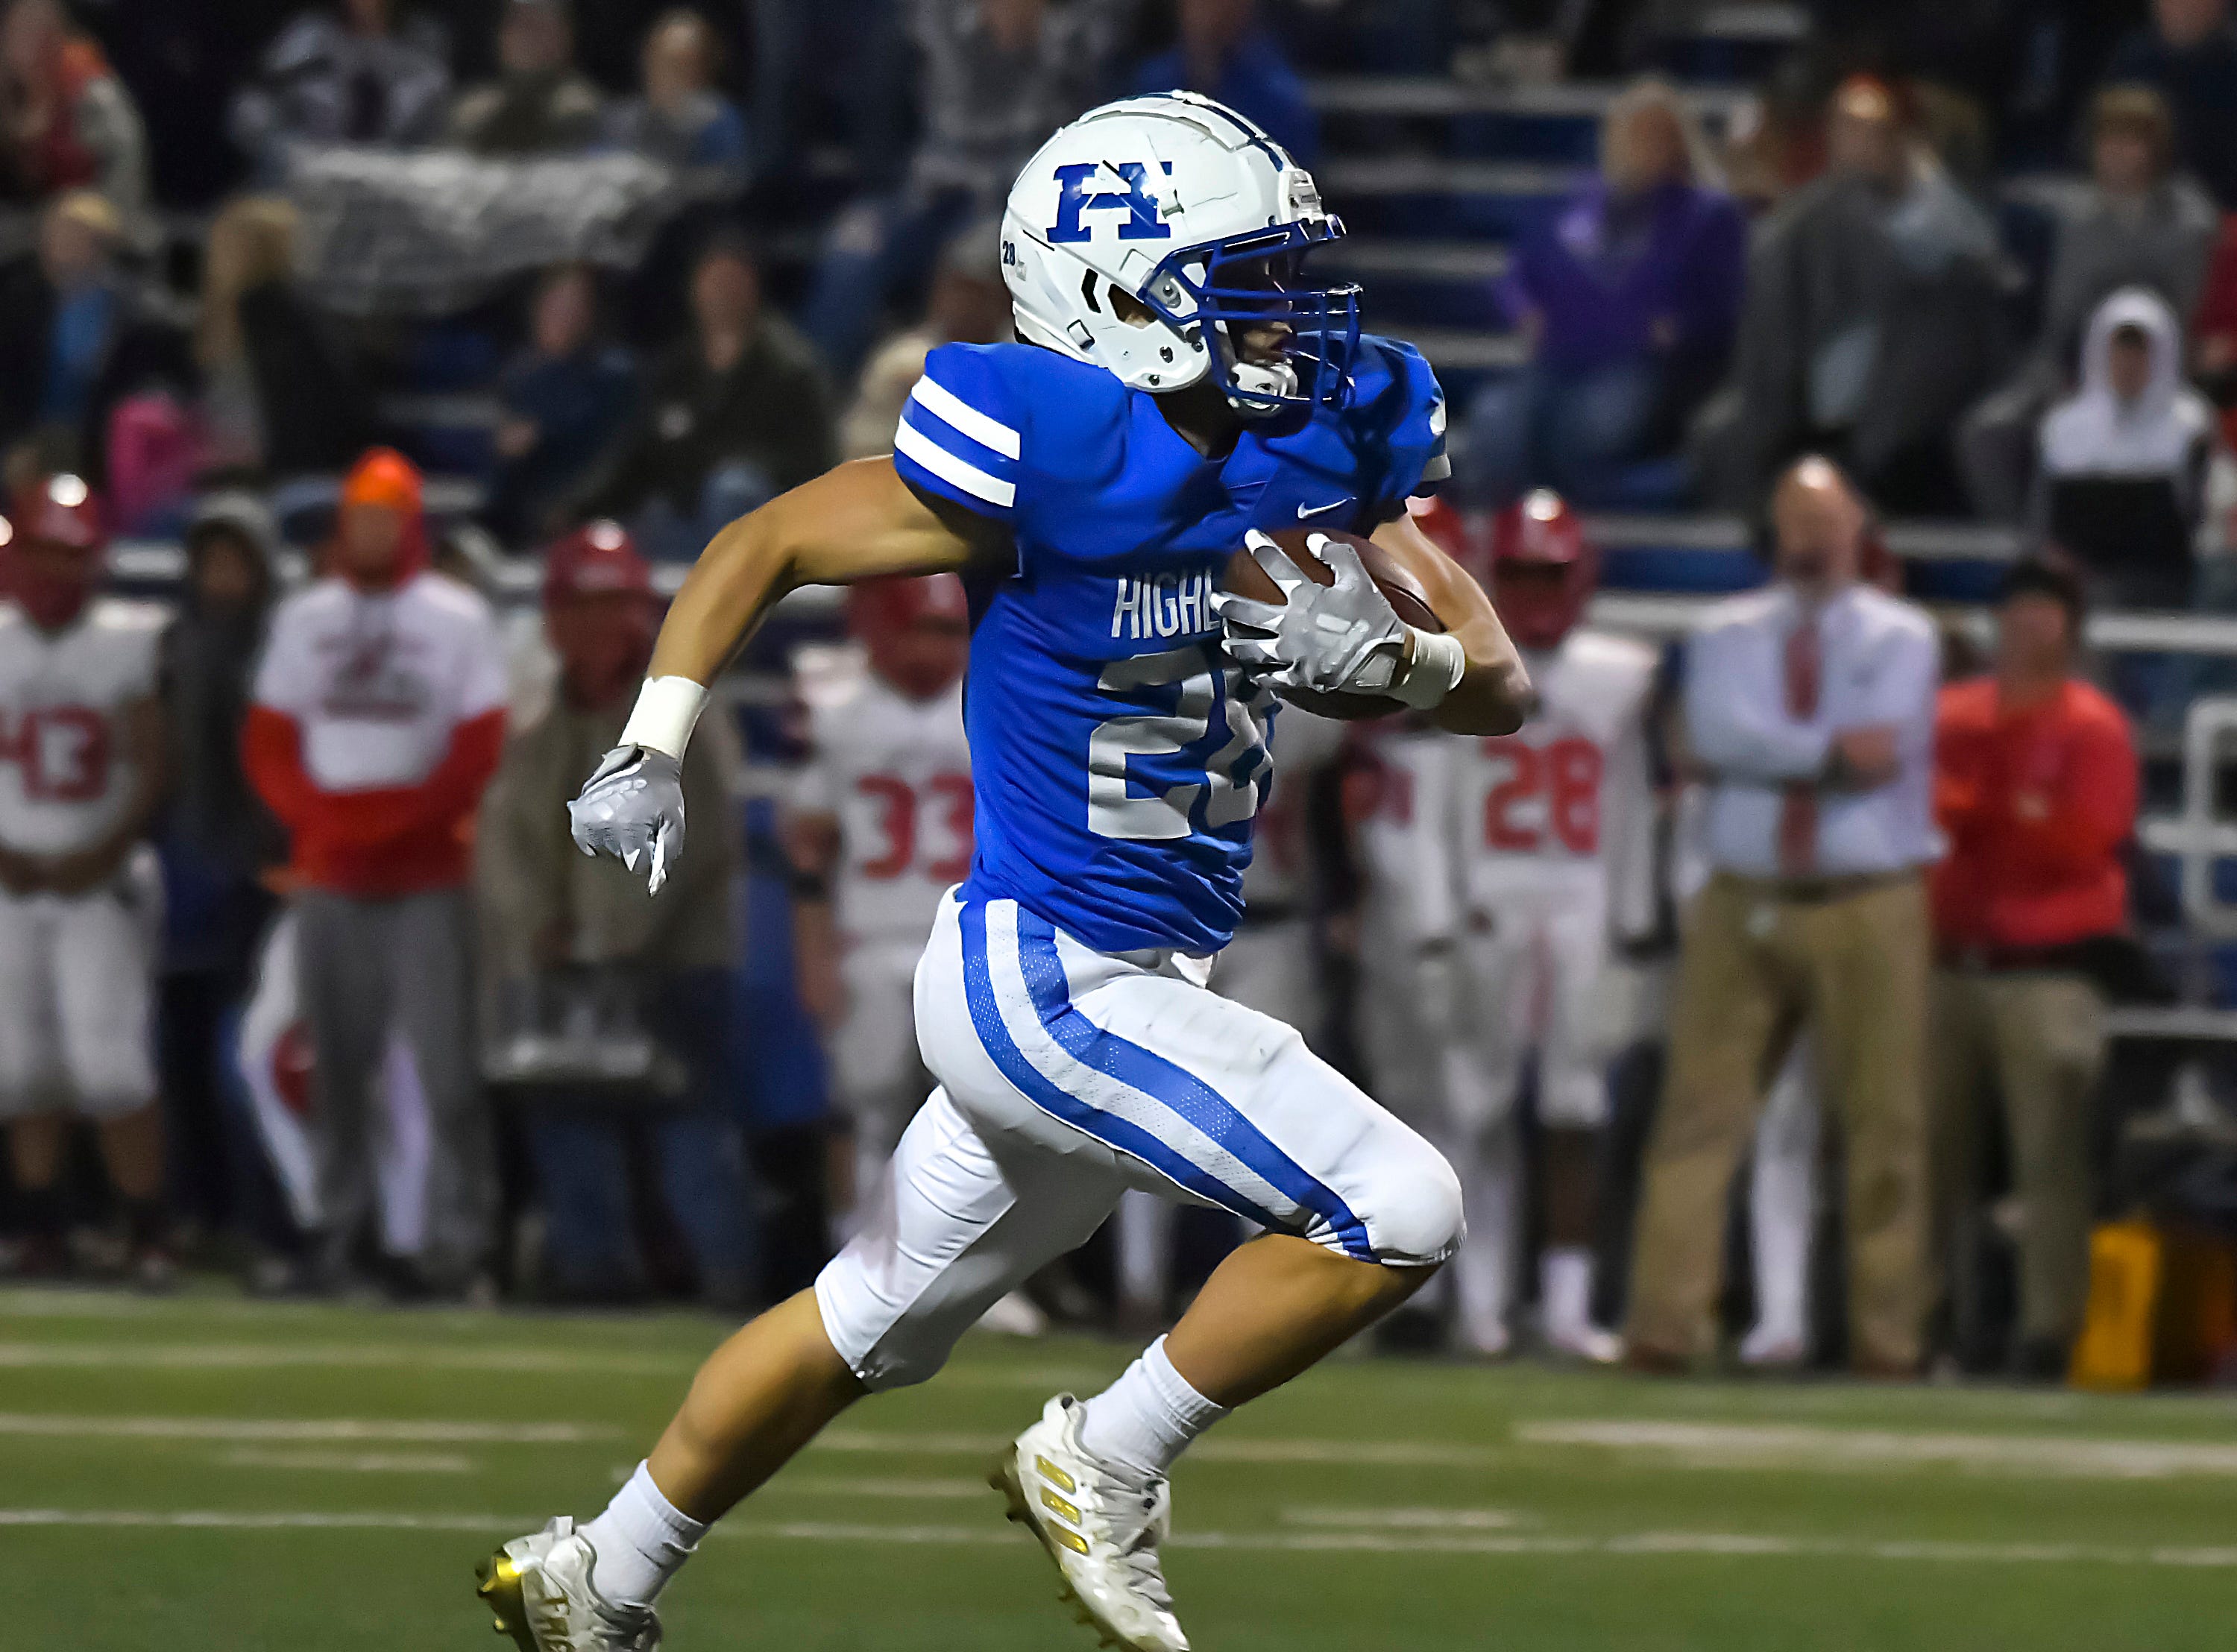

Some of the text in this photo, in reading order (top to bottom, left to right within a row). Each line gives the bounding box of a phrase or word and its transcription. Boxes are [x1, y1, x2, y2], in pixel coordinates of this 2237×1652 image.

[1112, 567, 1230, 640] HIGHL
[858, 773, 975, 881] 33
[1482, 733, 1603, 856] 28
